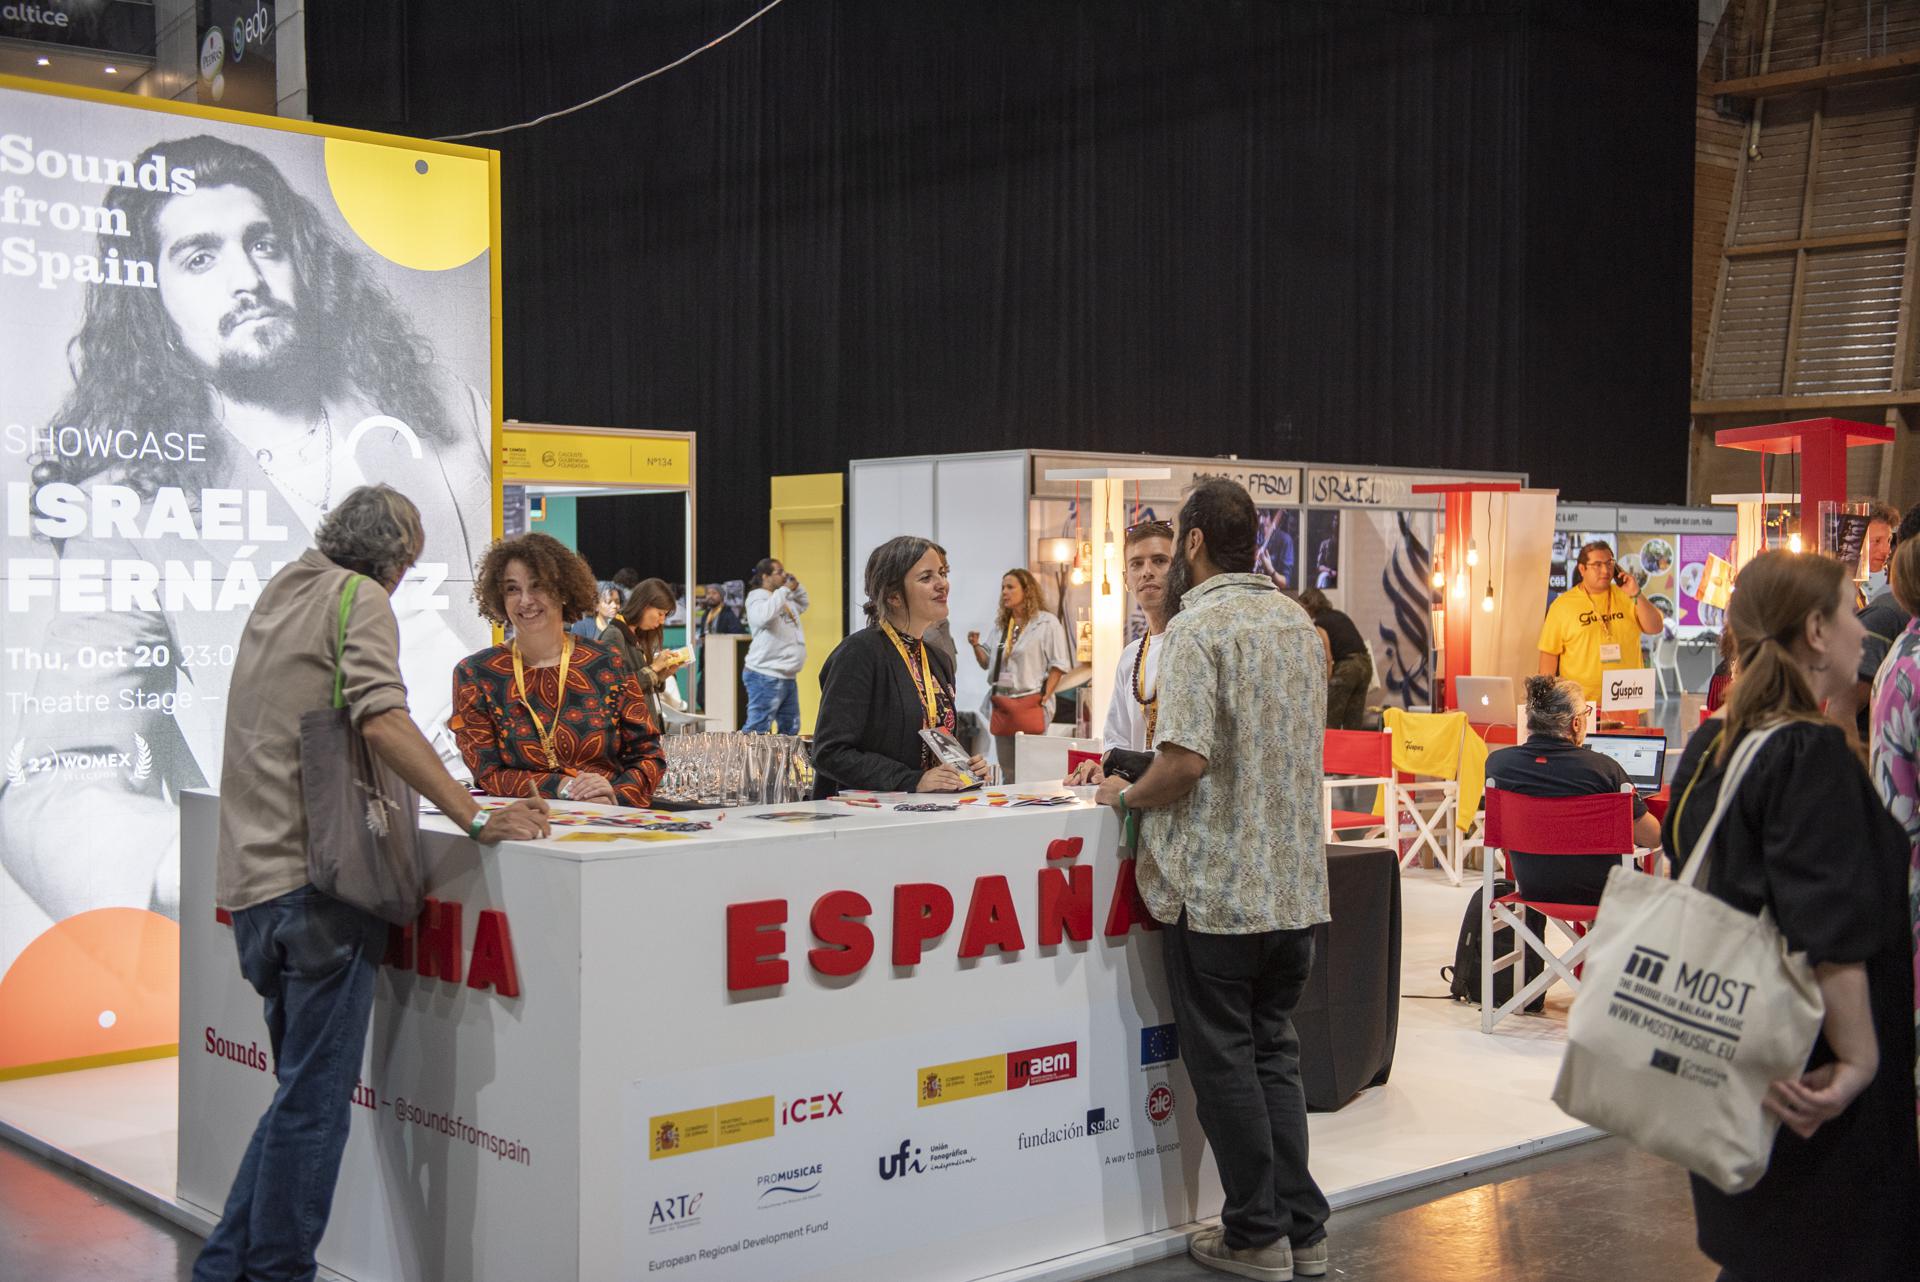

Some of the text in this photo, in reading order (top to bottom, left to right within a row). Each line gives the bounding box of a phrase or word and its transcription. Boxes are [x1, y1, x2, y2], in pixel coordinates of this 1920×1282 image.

[3, 5, 69, 27] altice
[245, 0, 268, 44] edp
[0, 134, 197, 196] Sounds
[0, 186, 131, 237] from
[1, 237, 158, 290] Spain
[4, 424, 207, 462] SHOWCASE
[8, 482, 289, 542] ISRAEL
[8, 545, 449, 613] FERNÁZ
[7, 644, 235, 671] Thu, Oct 20 23:0
[7, 690, 110, 715] Theatre
[119, 688, 192, 715] Stage
[60, 753, 131, 771] WOMEX
[726, 836, 1163, 991] ESPAÑA
[1674, 961, 1756, 1015] MOST
[206, 1026, 267, 1072] Sounds
[395, 1097, 530, 1166] @soundsfromspain
[930, 1143, 949, 1152] Unión
[1018, 1117, 1120, 1150] fundación sgae
[757, 1164, 823, 1186] PROMUSICAE
[879, 1139, 927, 1180] ufi
[930, 1148, 968, 1161] Fonográfica
[1105, 1156, 1111, 1165] A
[1112, 1154, 1126, 1164] way
[1127, 1151, 1135, 1160] to
[1135, 1147, 1155, 1159] make
[649, 1221, 829, 1272] European Regional Development Fund
